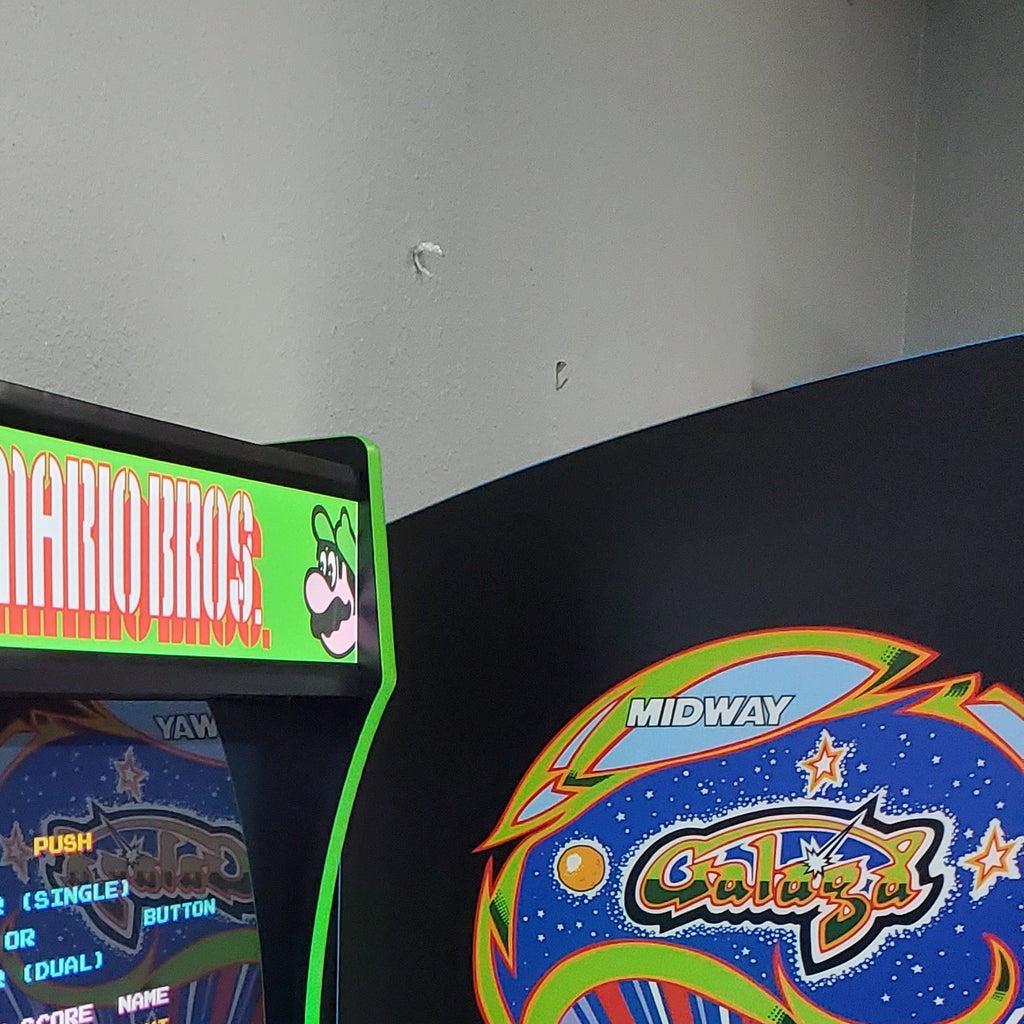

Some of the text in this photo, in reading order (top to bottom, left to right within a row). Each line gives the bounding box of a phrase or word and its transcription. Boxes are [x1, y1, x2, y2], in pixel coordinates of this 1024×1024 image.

[148, 472, 271, 649] BROS.
[626, 696, 794, 728] MIDWAY
[33, 832, 94, 857] PUSH
[23, 879, 130, 913] (SINGLE)
[640, 818, 930, 954] Galaga
[3, 898, 217, 951] OR BUTTON
[23, 951, 104, 985] (DUAL)
[118, 985, 170, 1016] NAME
